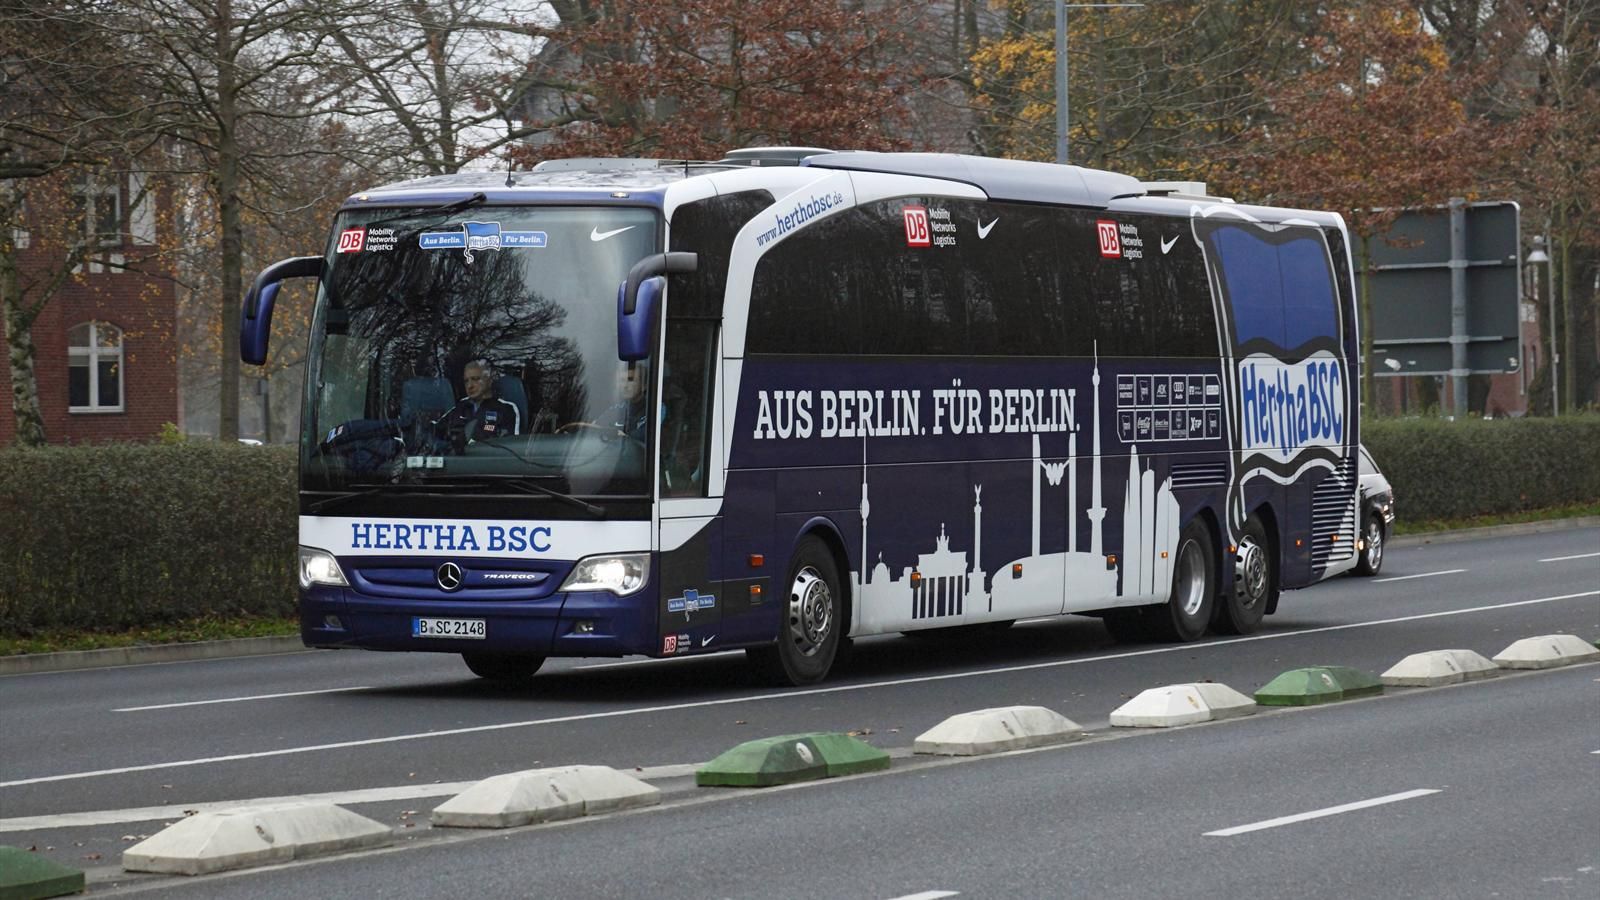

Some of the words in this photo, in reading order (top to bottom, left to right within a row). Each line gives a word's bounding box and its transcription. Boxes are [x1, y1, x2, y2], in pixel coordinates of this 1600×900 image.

[757, 192, 843, 247] www.herthabsc.de
[929, 207, 951, 222] Mobility
[369, 229, 395, 237] Mobility
[907, 212, 928, 241] DB
[931, 221, 957, 232] Networks
[340, 232, 362, 250] DB
[424, 236, 438, 244] Aus
[933, 234, 956, 248] Logistics
[1100, 225, 1119, 252] DB
[366, 244, 394, 252] Logistics
[754, 390, 814, 440] AUS
[819, 389, 925, 438] BERLIN.
[933, 378, 984, 436] FÜR
[989, 388, 1081, 435] BERLIN.
[352, 523, 480, 551] HERTHA
[487, 525, 552, 552] BSC
[420, 620, 428, 634] B
[436, 621, 451, 635] SC
[454, 621, 484, 636] 2148
[664, 637, 677, 652] DB
